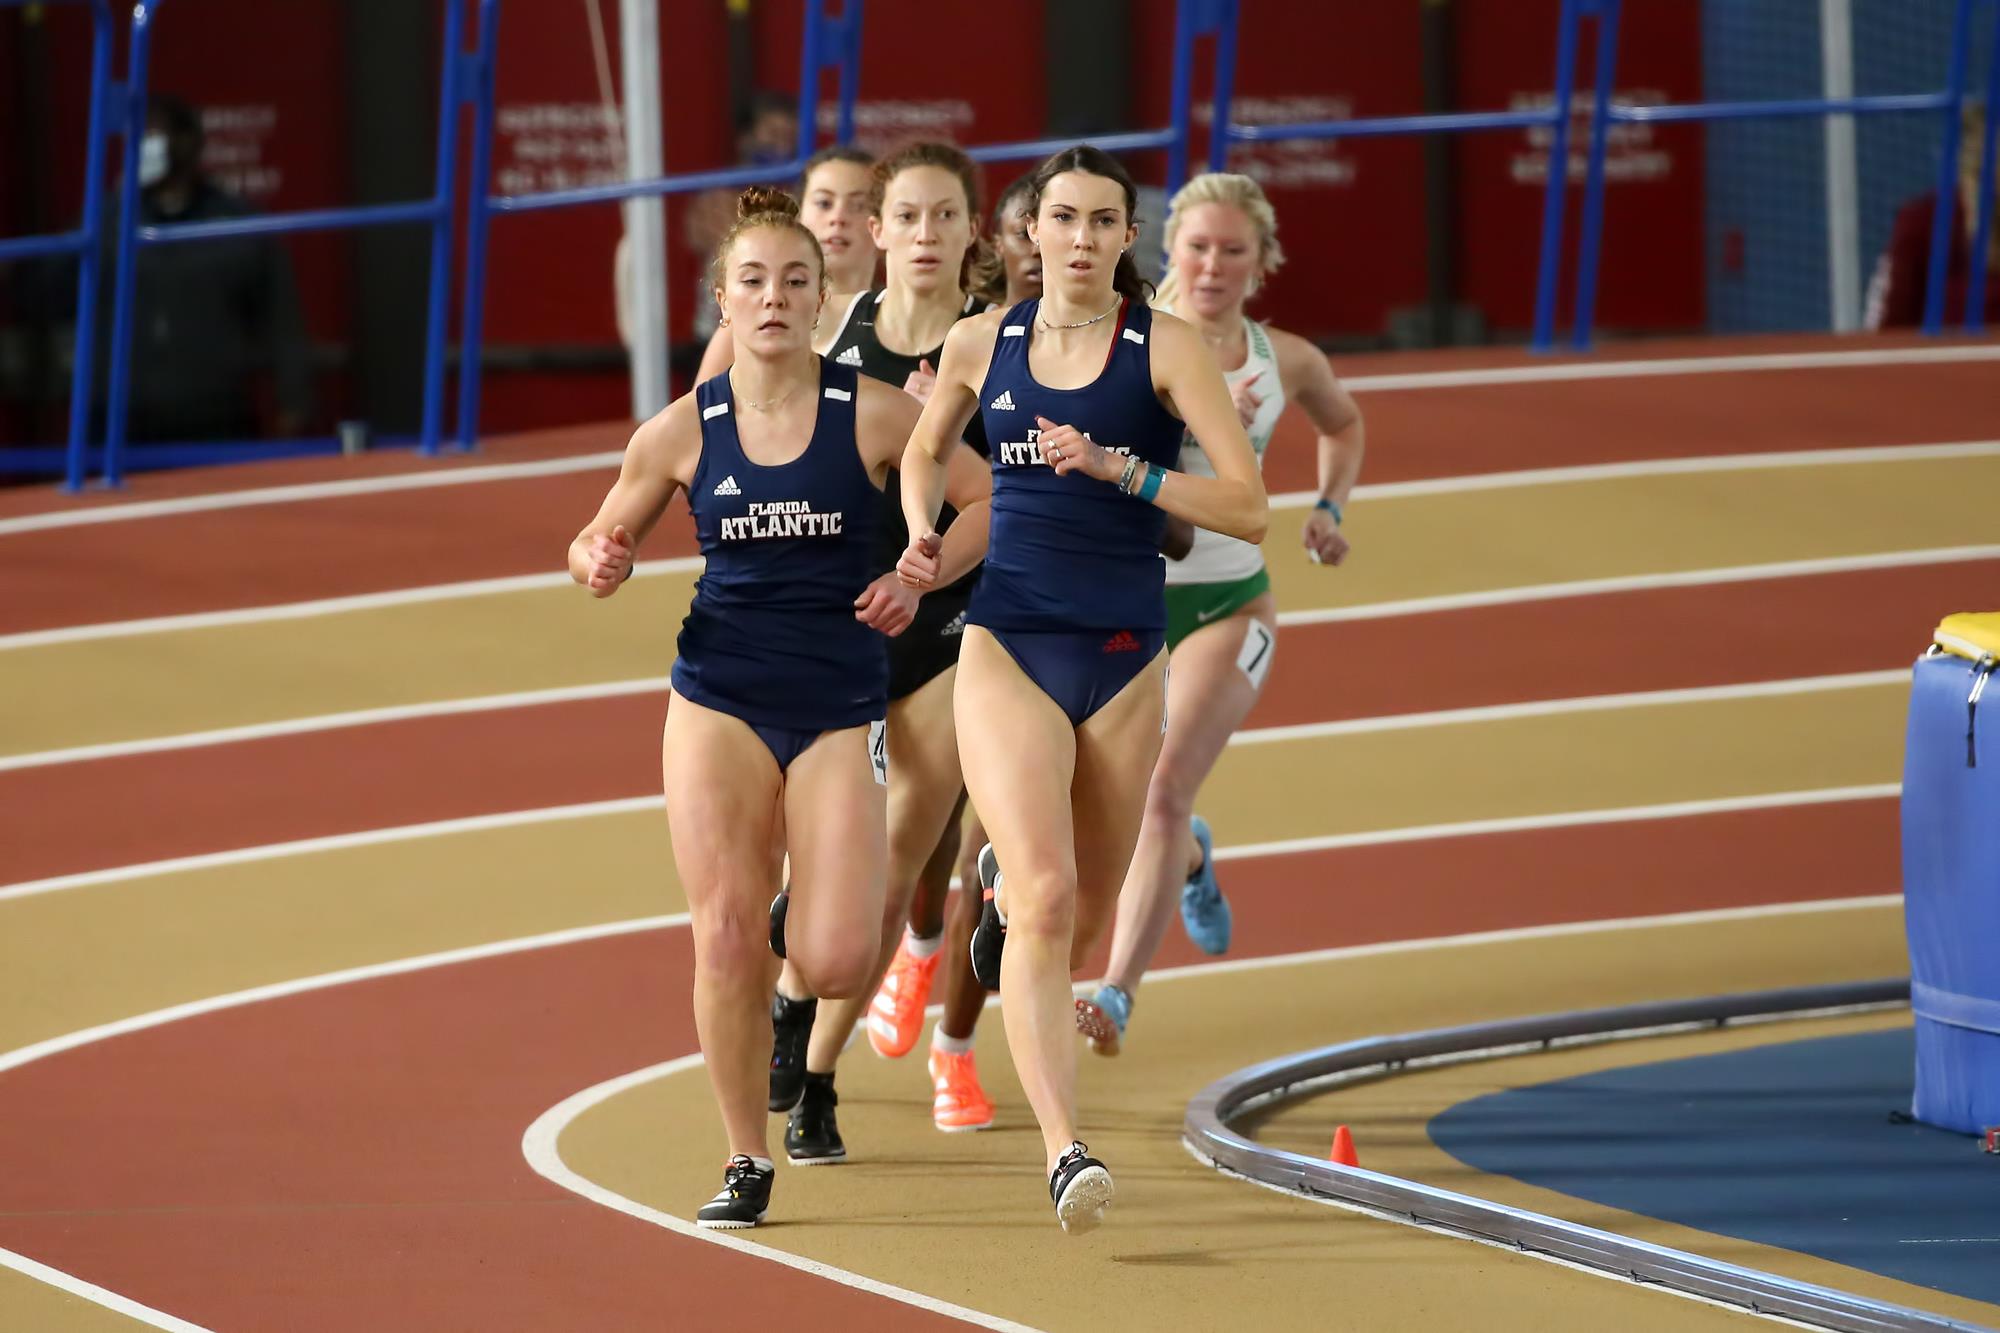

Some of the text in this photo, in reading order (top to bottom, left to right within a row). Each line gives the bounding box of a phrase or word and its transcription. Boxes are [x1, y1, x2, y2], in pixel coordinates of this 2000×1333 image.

[991, 402, 1016, 411] adidas
[714, 488, 741, 496] adidas
[749, 501, 811, 515] FLORIDA
[721, 512, 842, 540] ATLANTIC
[1247, 628, 1269, 673] 7
